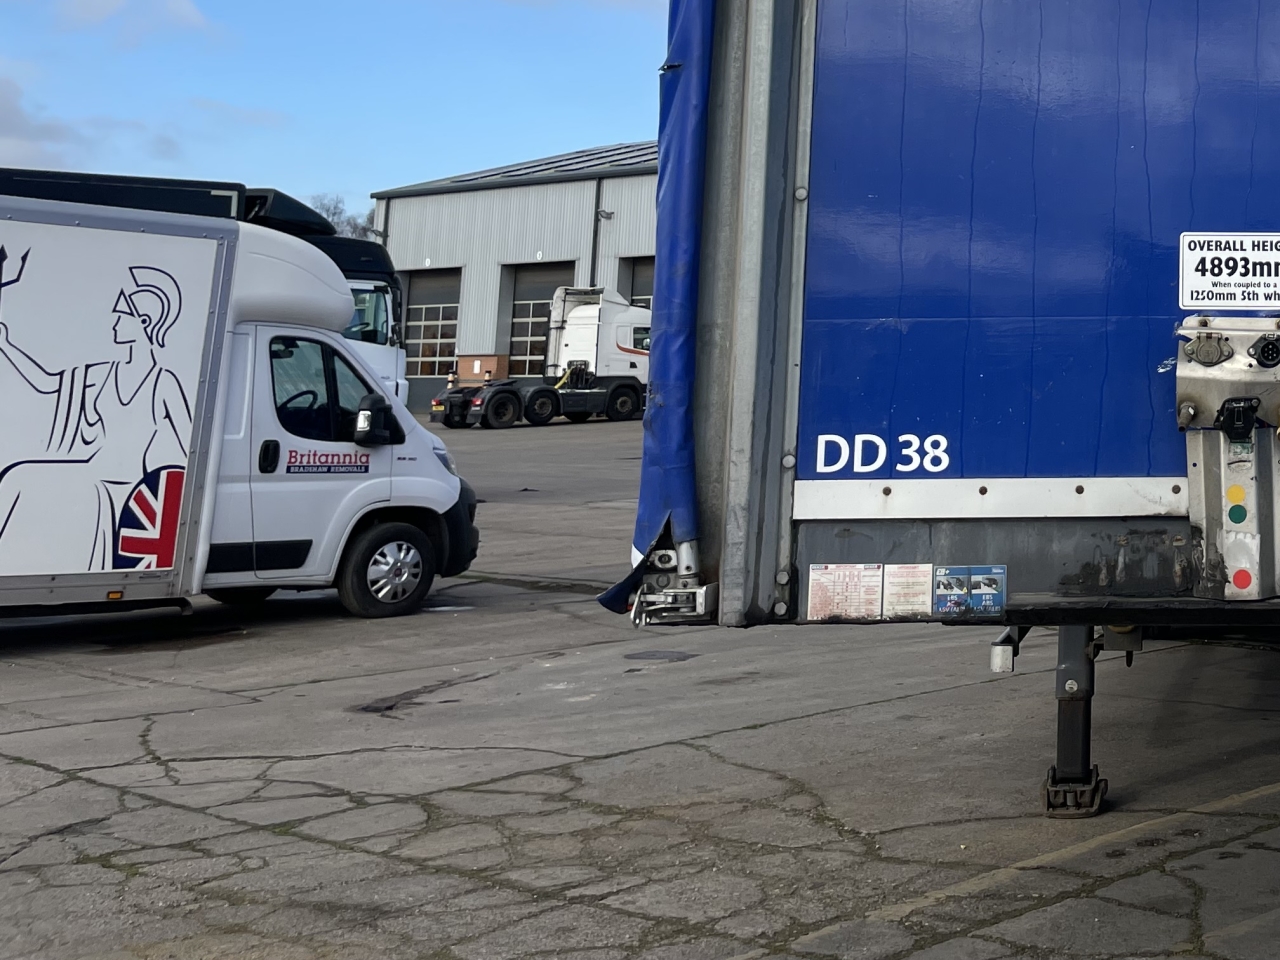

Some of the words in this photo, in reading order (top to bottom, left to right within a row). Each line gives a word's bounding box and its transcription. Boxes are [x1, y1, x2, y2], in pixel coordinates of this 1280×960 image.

[1187, 239, 1247, 252] OVERALL
[1233, 281, 1261, 290] coupled
[1190, 290, 1237, 301] 1250mm
[1240, 290, 1259, 301] 5th
[287, 450, 370, 465] Britannia
[815, 433, 887, 473] DD
[895, 433, 950, 473] 38
